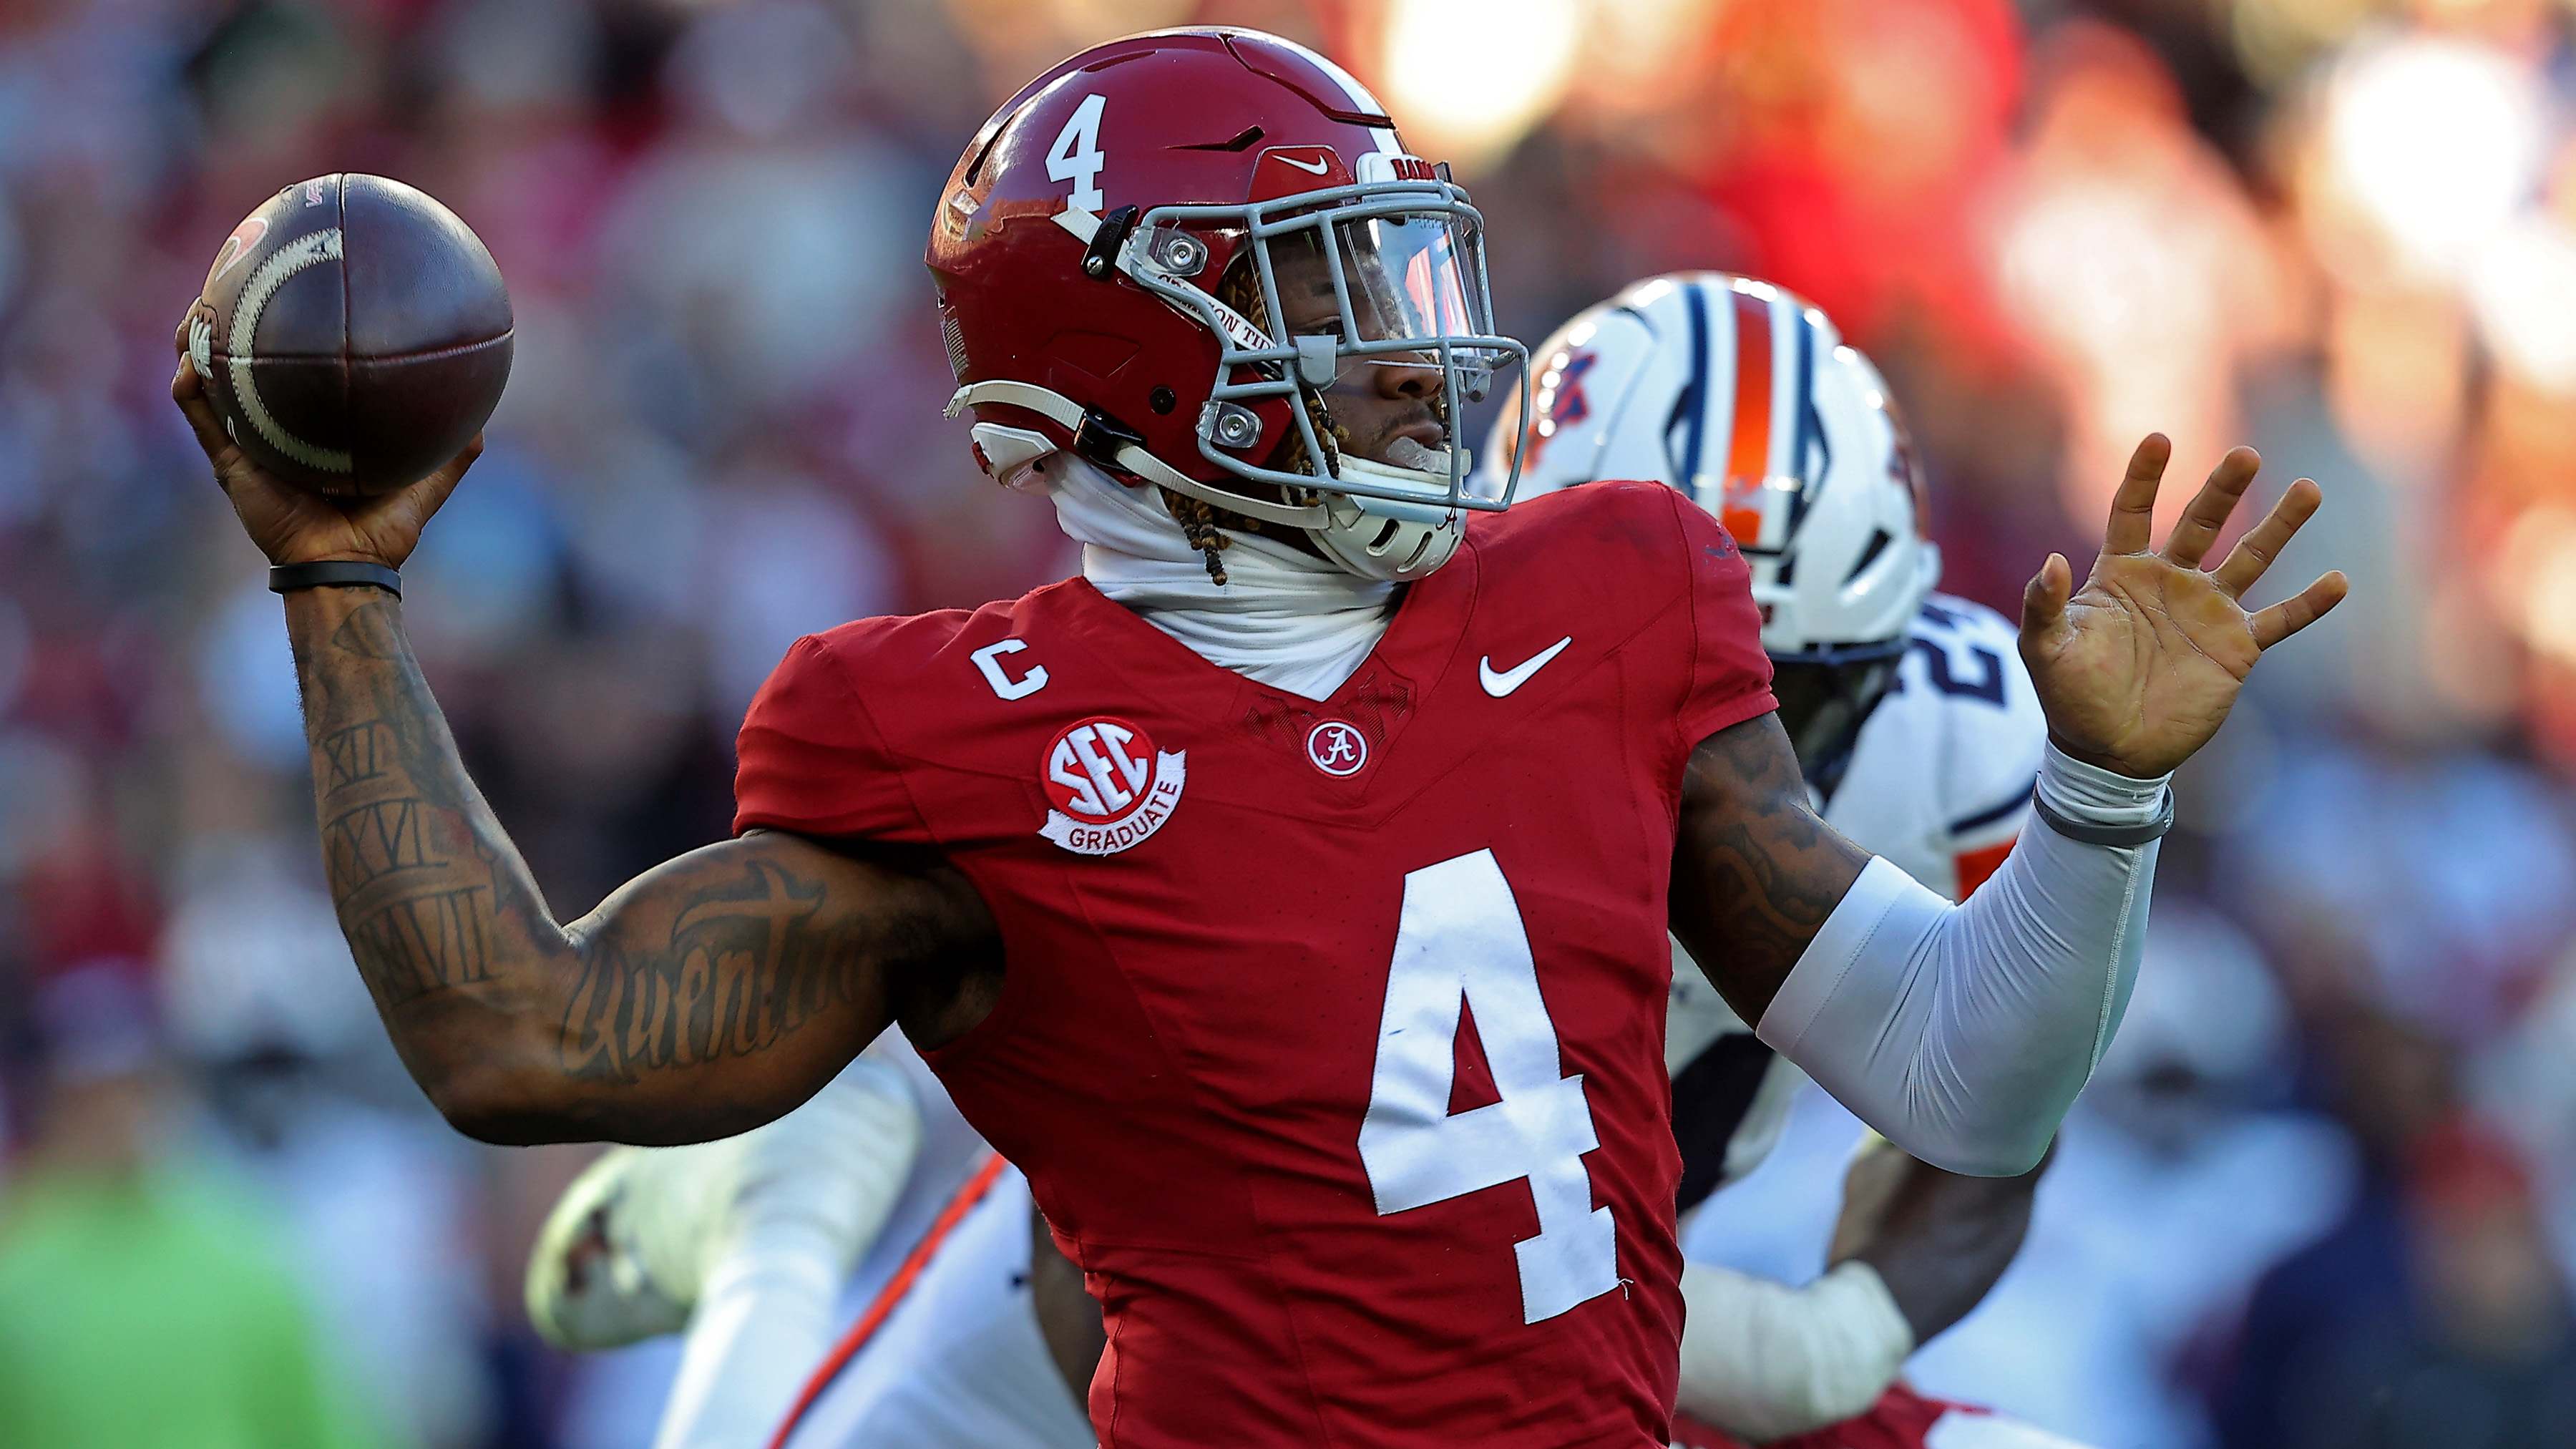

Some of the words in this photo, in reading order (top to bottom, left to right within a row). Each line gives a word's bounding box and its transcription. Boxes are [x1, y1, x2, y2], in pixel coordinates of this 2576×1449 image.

[1045, 92, 1107, 213] 4
[1243, 325, 1276, 350] TID
[970, 638, 1050, 701] C
[1049, 722, 1148, 816] SEC
[1319, 728, 1357, 766] A
[1069, 780, 1177, 850] GRADUATE
[1357, 847, 1619, 1325] 4
